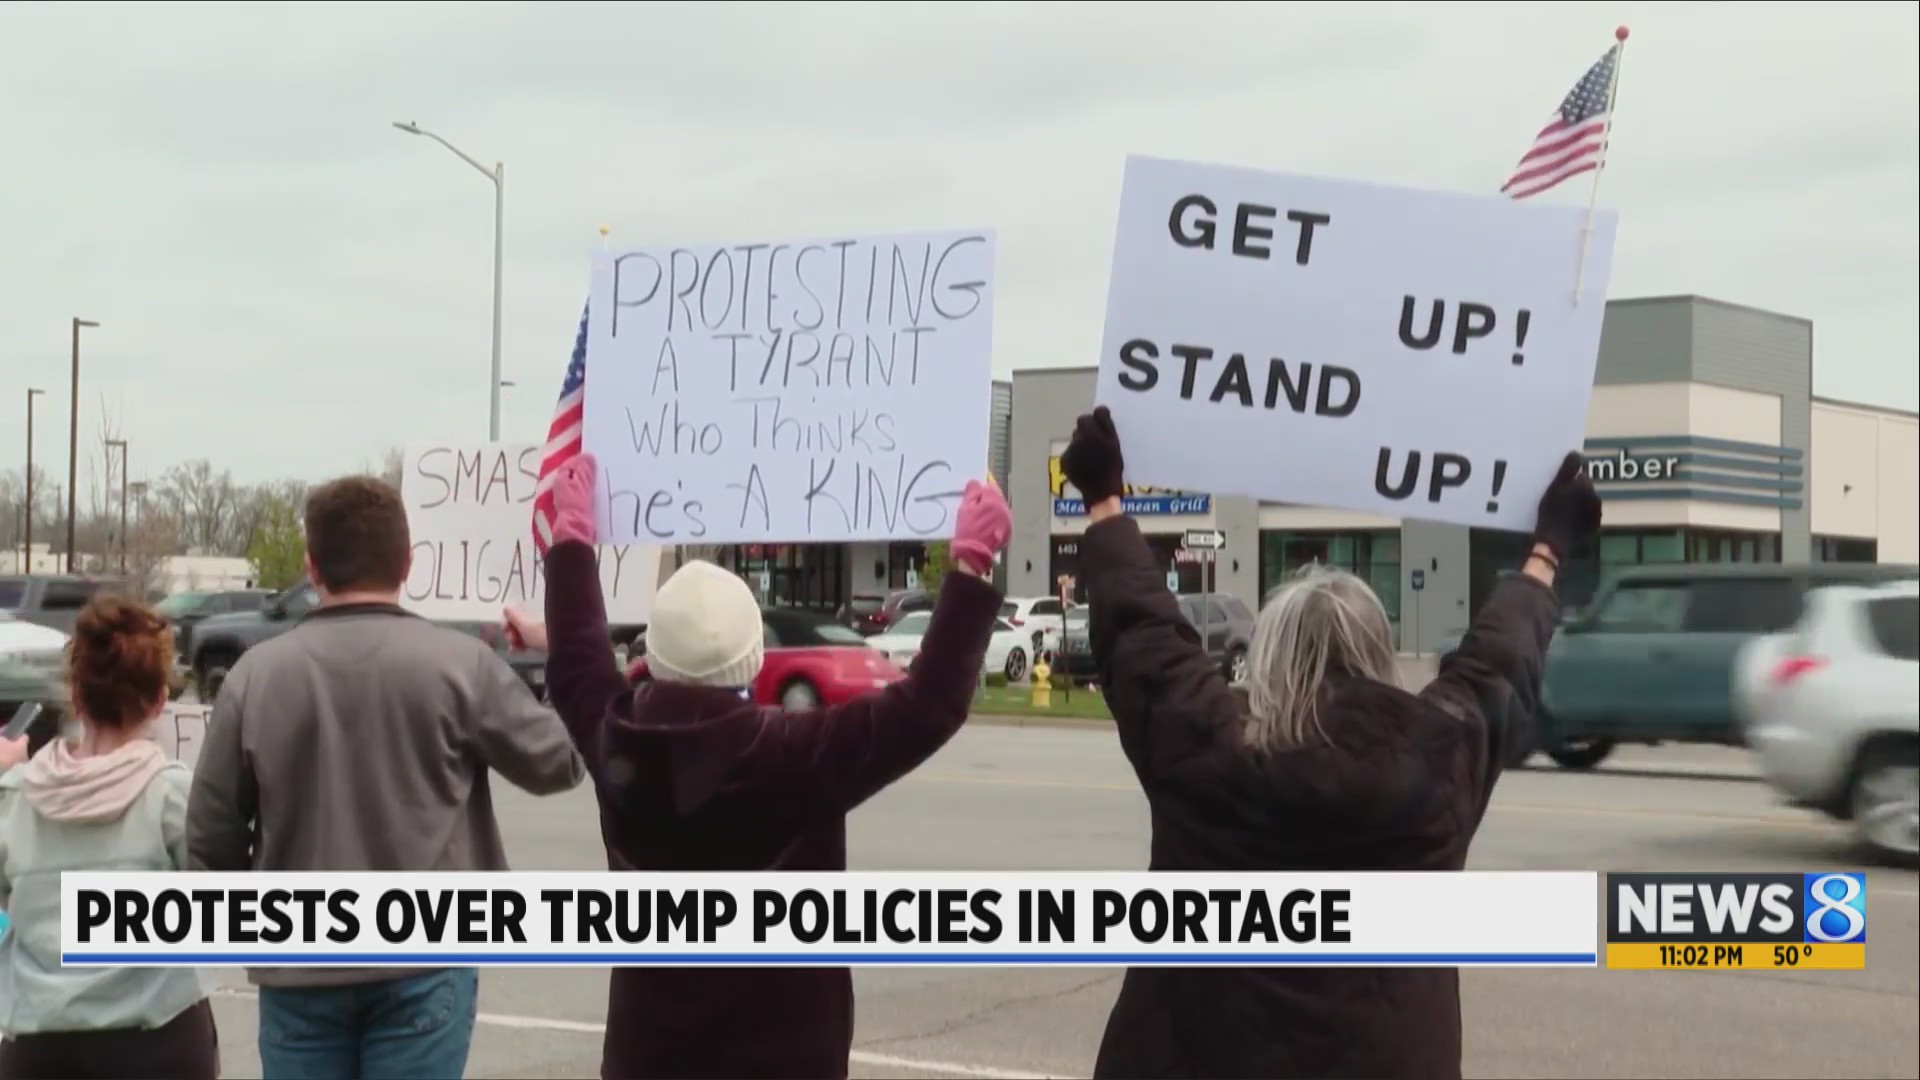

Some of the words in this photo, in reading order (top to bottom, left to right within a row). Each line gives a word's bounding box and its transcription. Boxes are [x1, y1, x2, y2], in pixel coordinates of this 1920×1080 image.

[1168, 193, 1331, 266] GET
[611, 236, 987, 338] PROTESTING
[652, 336, 679, 397] A
[711, 327, 938, 392] TYRANT
[1398, 294, 1532, 366] UP!
[1117, 338, 1362, 418] STAND
[624, 399, 724, 457] Who
[417, 447, 541, 509] SMAS
[604, 465, 707, 538] he's
[724, 462, 770, 532] A
[803, 452, 968, 536] KING
[1373, 446, 1508, 514] UP!
[1587, 448, 1678, 479] mber
[1170, 498, 1206, 513] Grill
